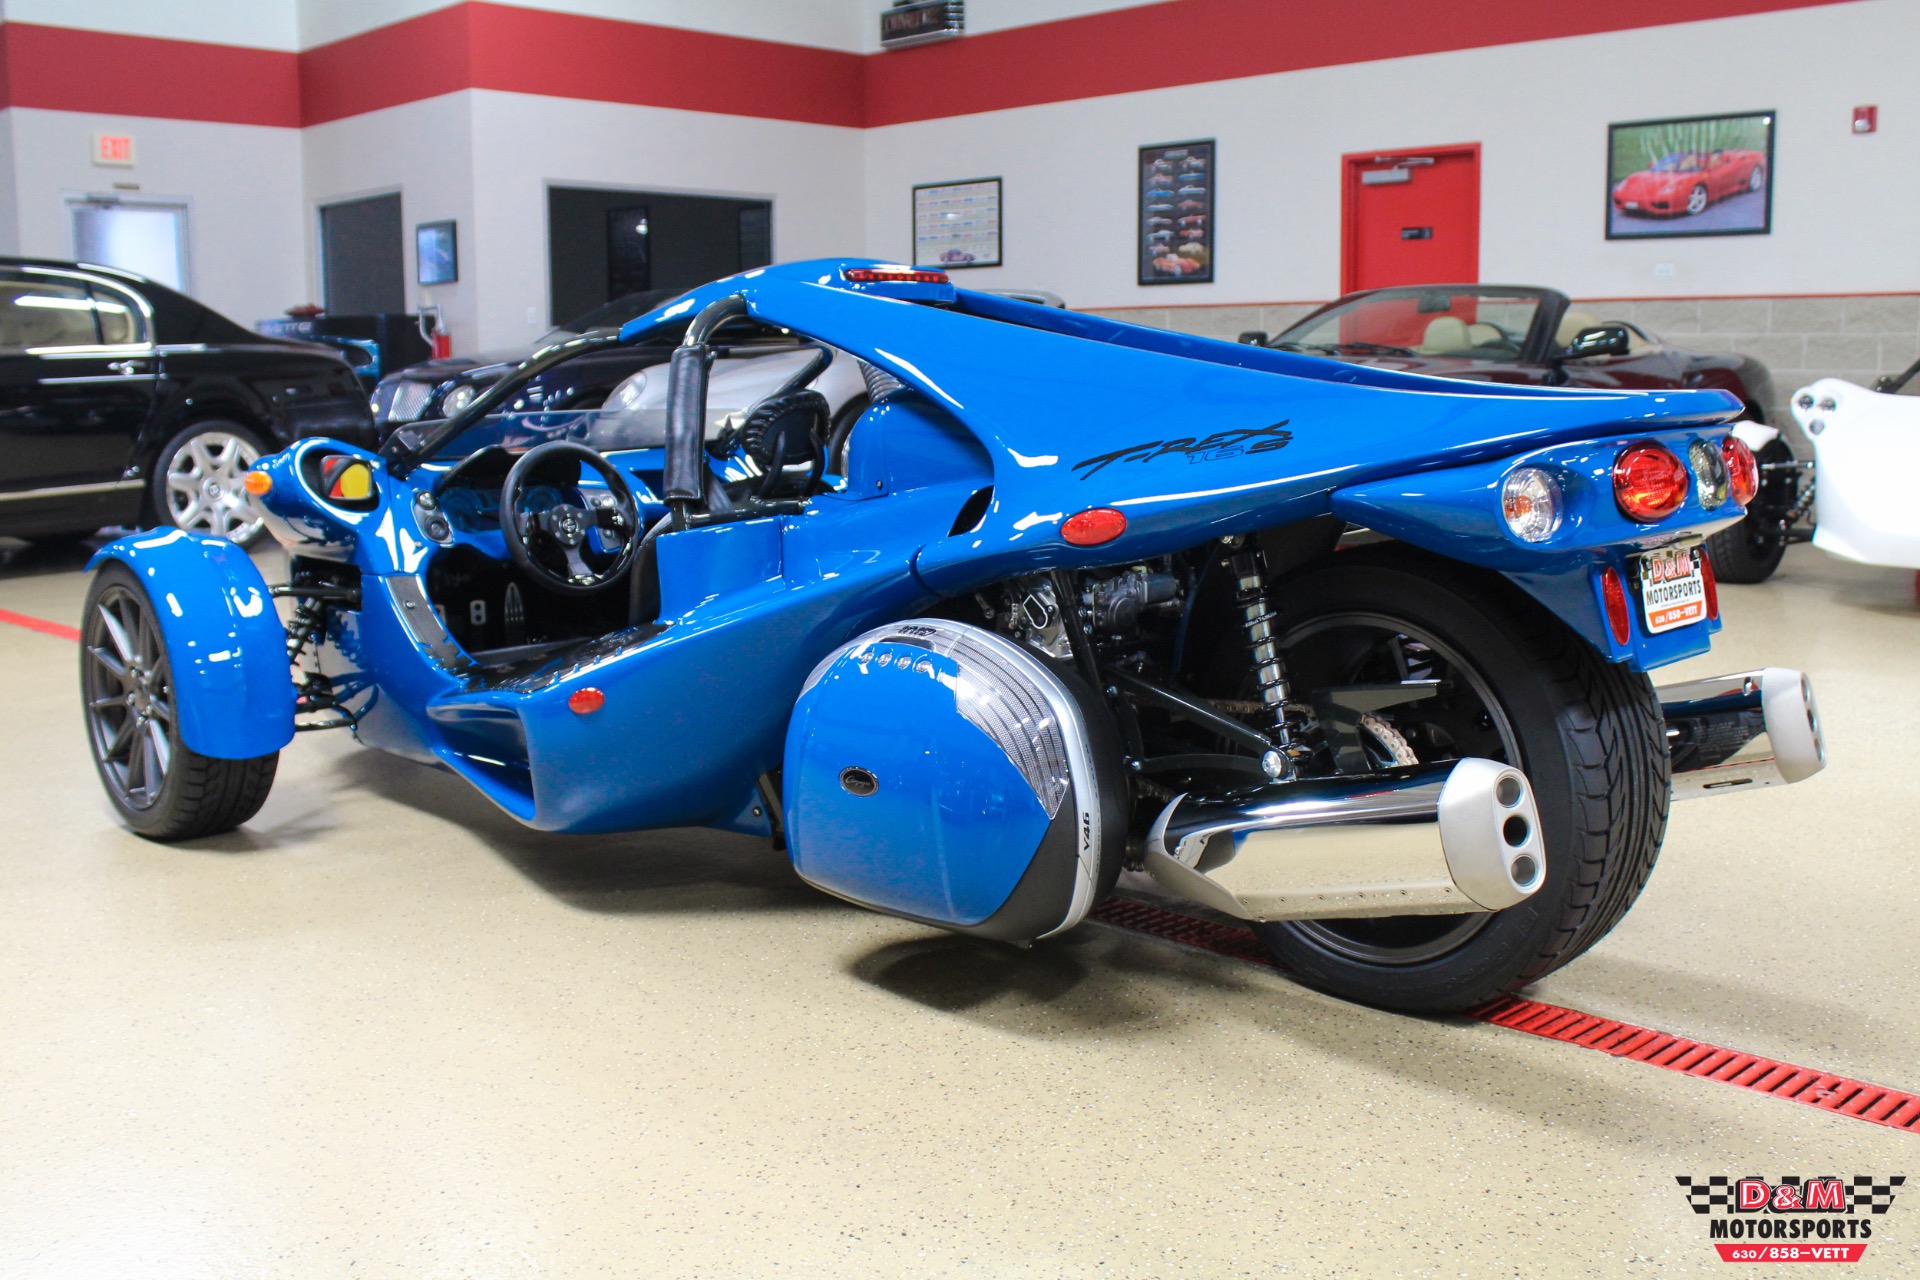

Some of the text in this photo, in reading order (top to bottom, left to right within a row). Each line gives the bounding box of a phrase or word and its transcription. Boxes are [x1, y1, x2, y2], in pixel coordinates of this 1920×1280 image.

[101, 135, 130, 160] EXIT
[1071, 419, 1293, 480] T-REX
[1650, 551, 1693, 584] D&M
[1646, 579, 1702, 606] MOTORSPORTS
[1082, 811, 1091, 851] V46
